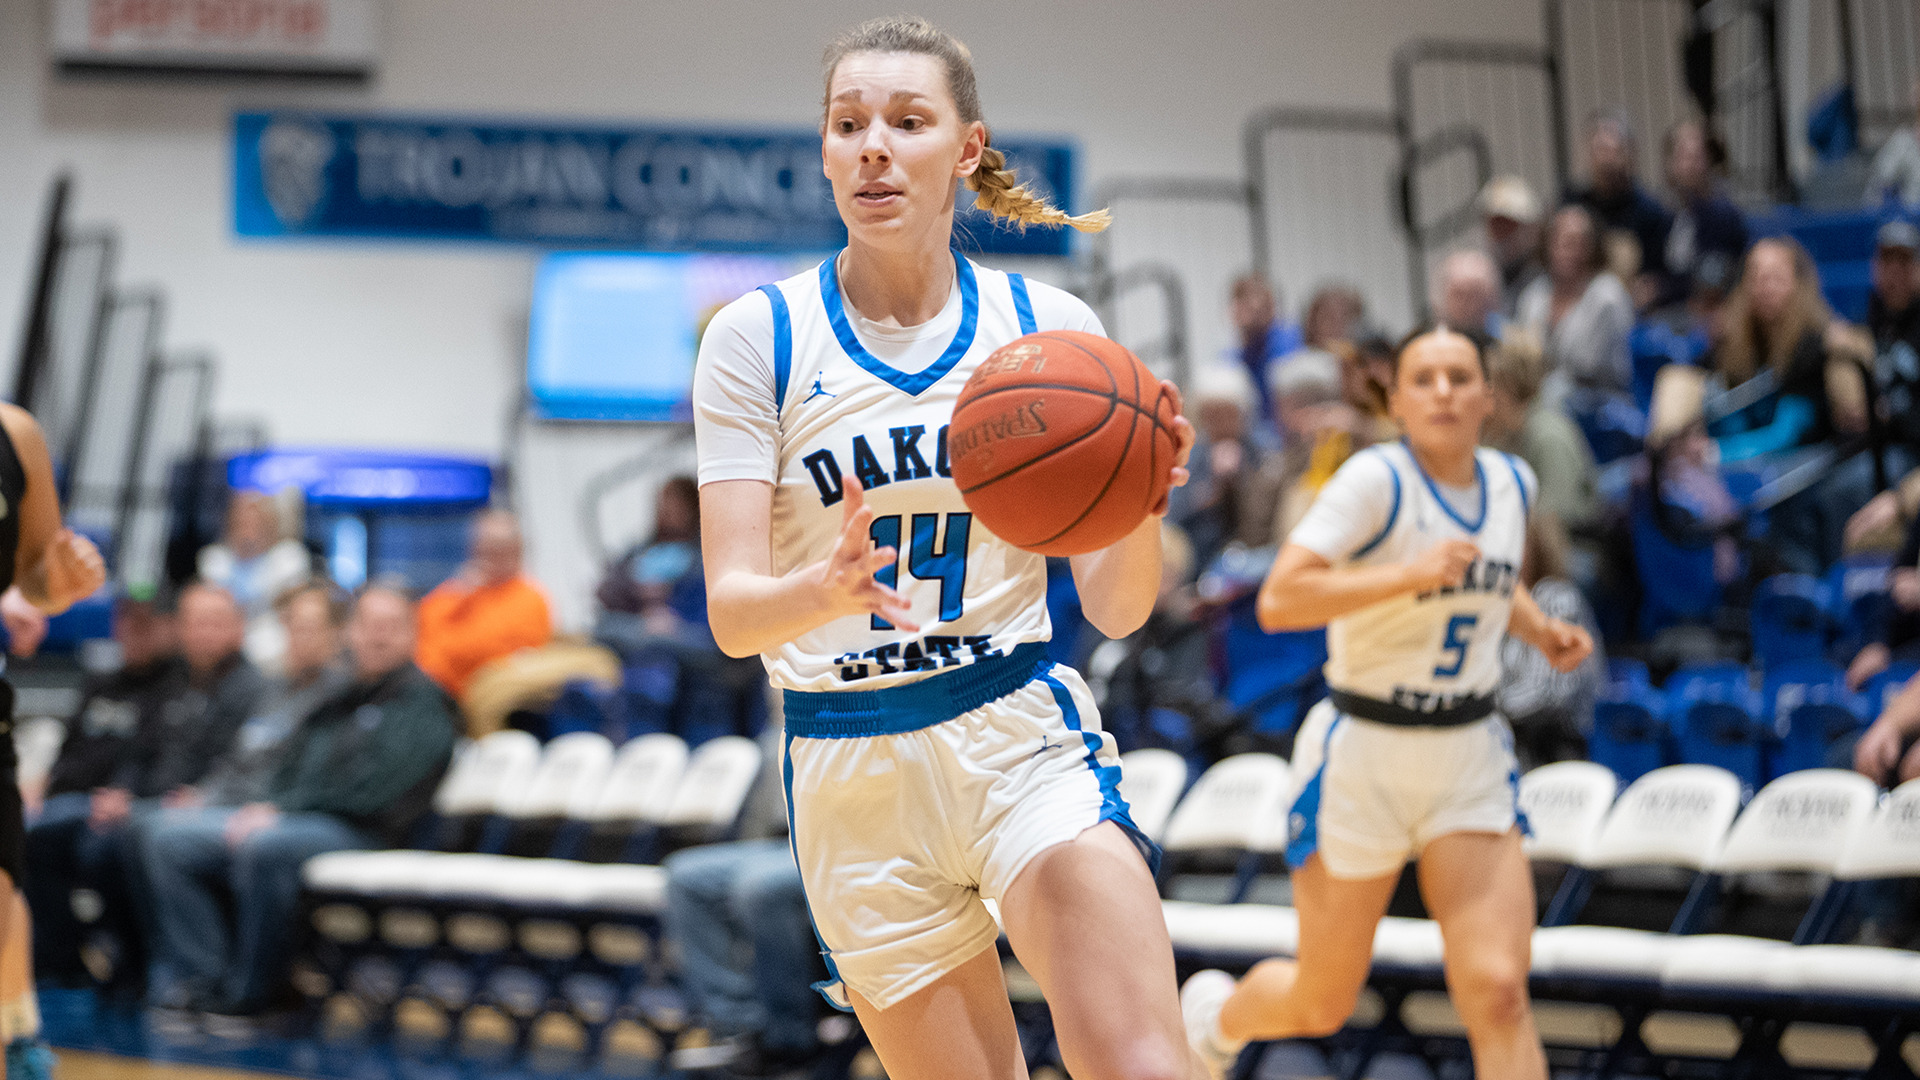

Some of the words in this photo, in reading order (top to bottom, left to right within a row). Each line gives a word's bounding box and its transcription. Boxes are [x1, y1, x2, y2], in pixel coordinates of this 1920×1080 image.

[612, 130, 846, 222] CONCE
[869, 512, 973, 631] 14
[1433, 613, 1478, 678] 5
